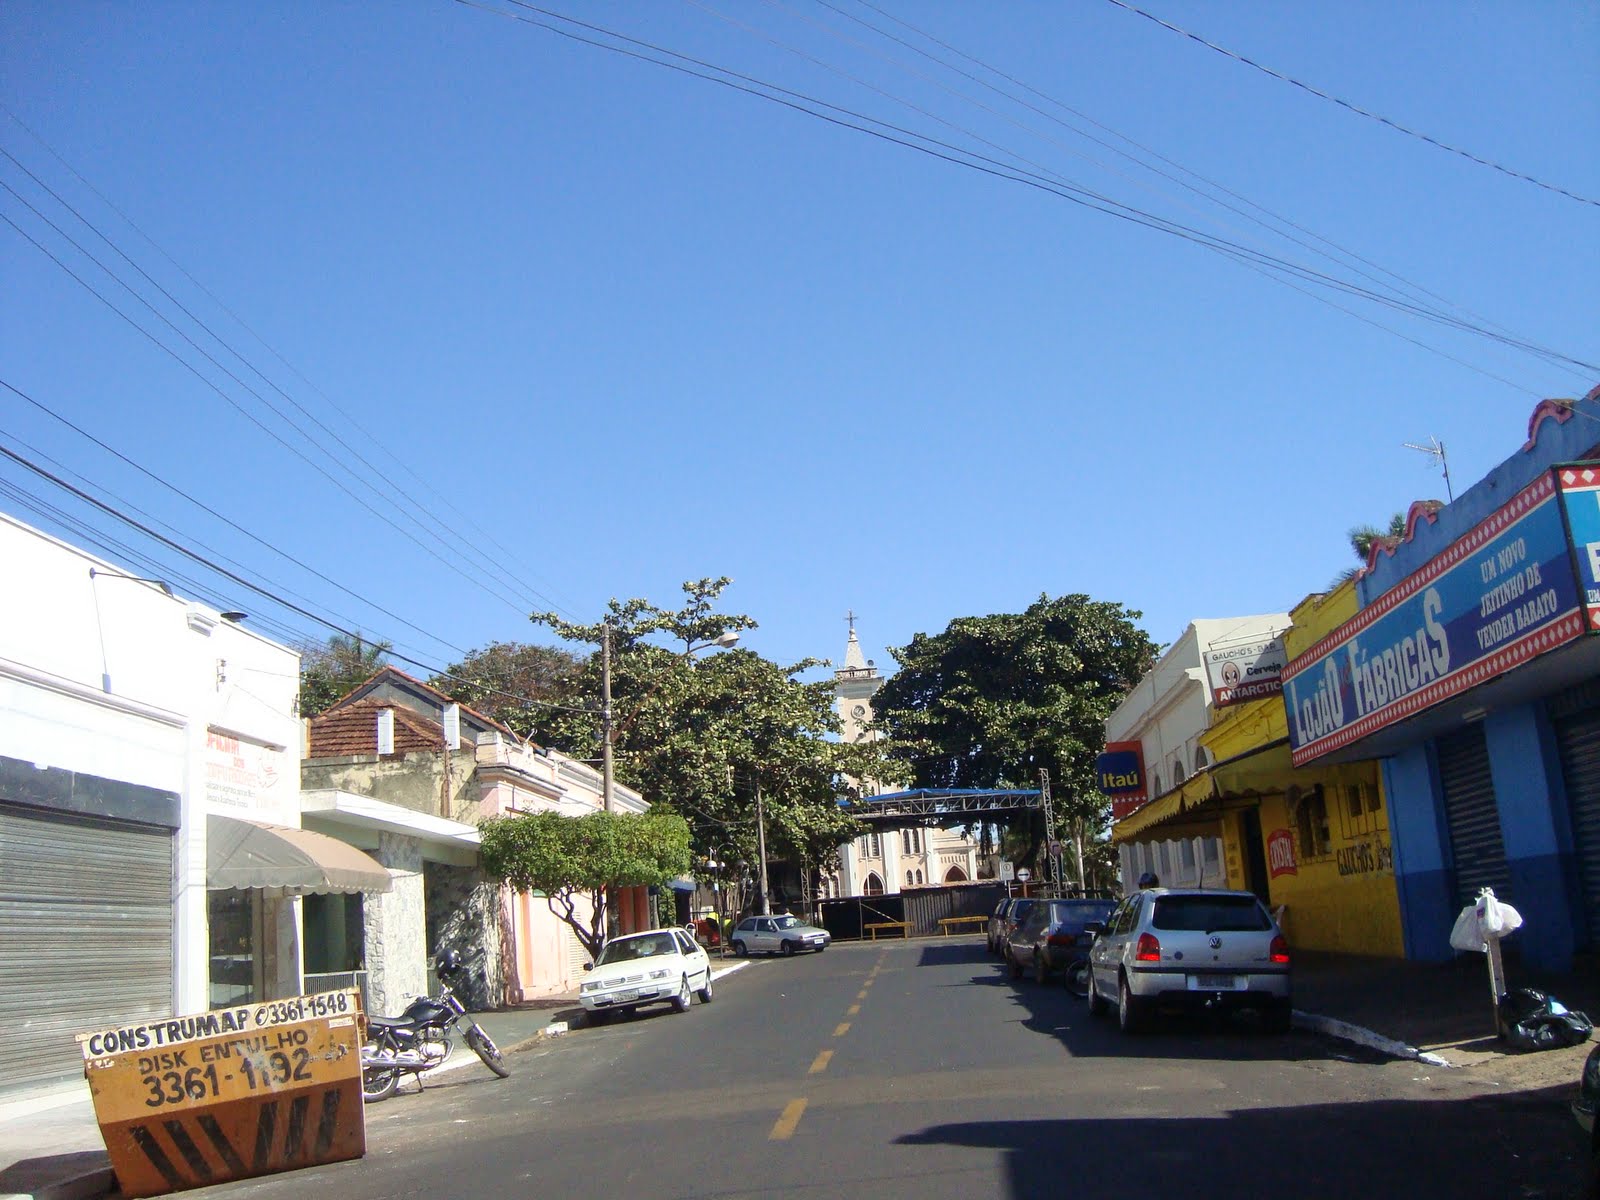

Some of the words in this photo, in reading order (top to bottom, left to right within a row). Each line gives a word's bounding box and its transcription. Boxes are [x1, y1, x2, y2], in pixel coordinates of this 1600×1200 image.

[1481, 557, 1497, 583] UM
[1498, 537, 1526, 574] NOVO
[1481, 572, 1525, 618] JEITINHO
[1525, 561, 1541, 590] DE
[1477, 613, 1516, 650] VENDER
[1515, 588, 1558, 631] BARATO
[1246, 662, 1282, 676] Cerveja
[1290, 656, 1344, 746] LOJÃO
[1347, 587, 1450, 716] FÁBRICAS
[1220, 680, 1282, 702] ANTARCTIC
[1102, 770, 1138, 788] Itaú
[89, 1008, 251, 1056] CONSTRUMAP
[269, 992, 348, 1024] 3361-1548
[138, 1050, 189, 1075] DISK
[200, 1028, 309, 1063] ENTULHO
